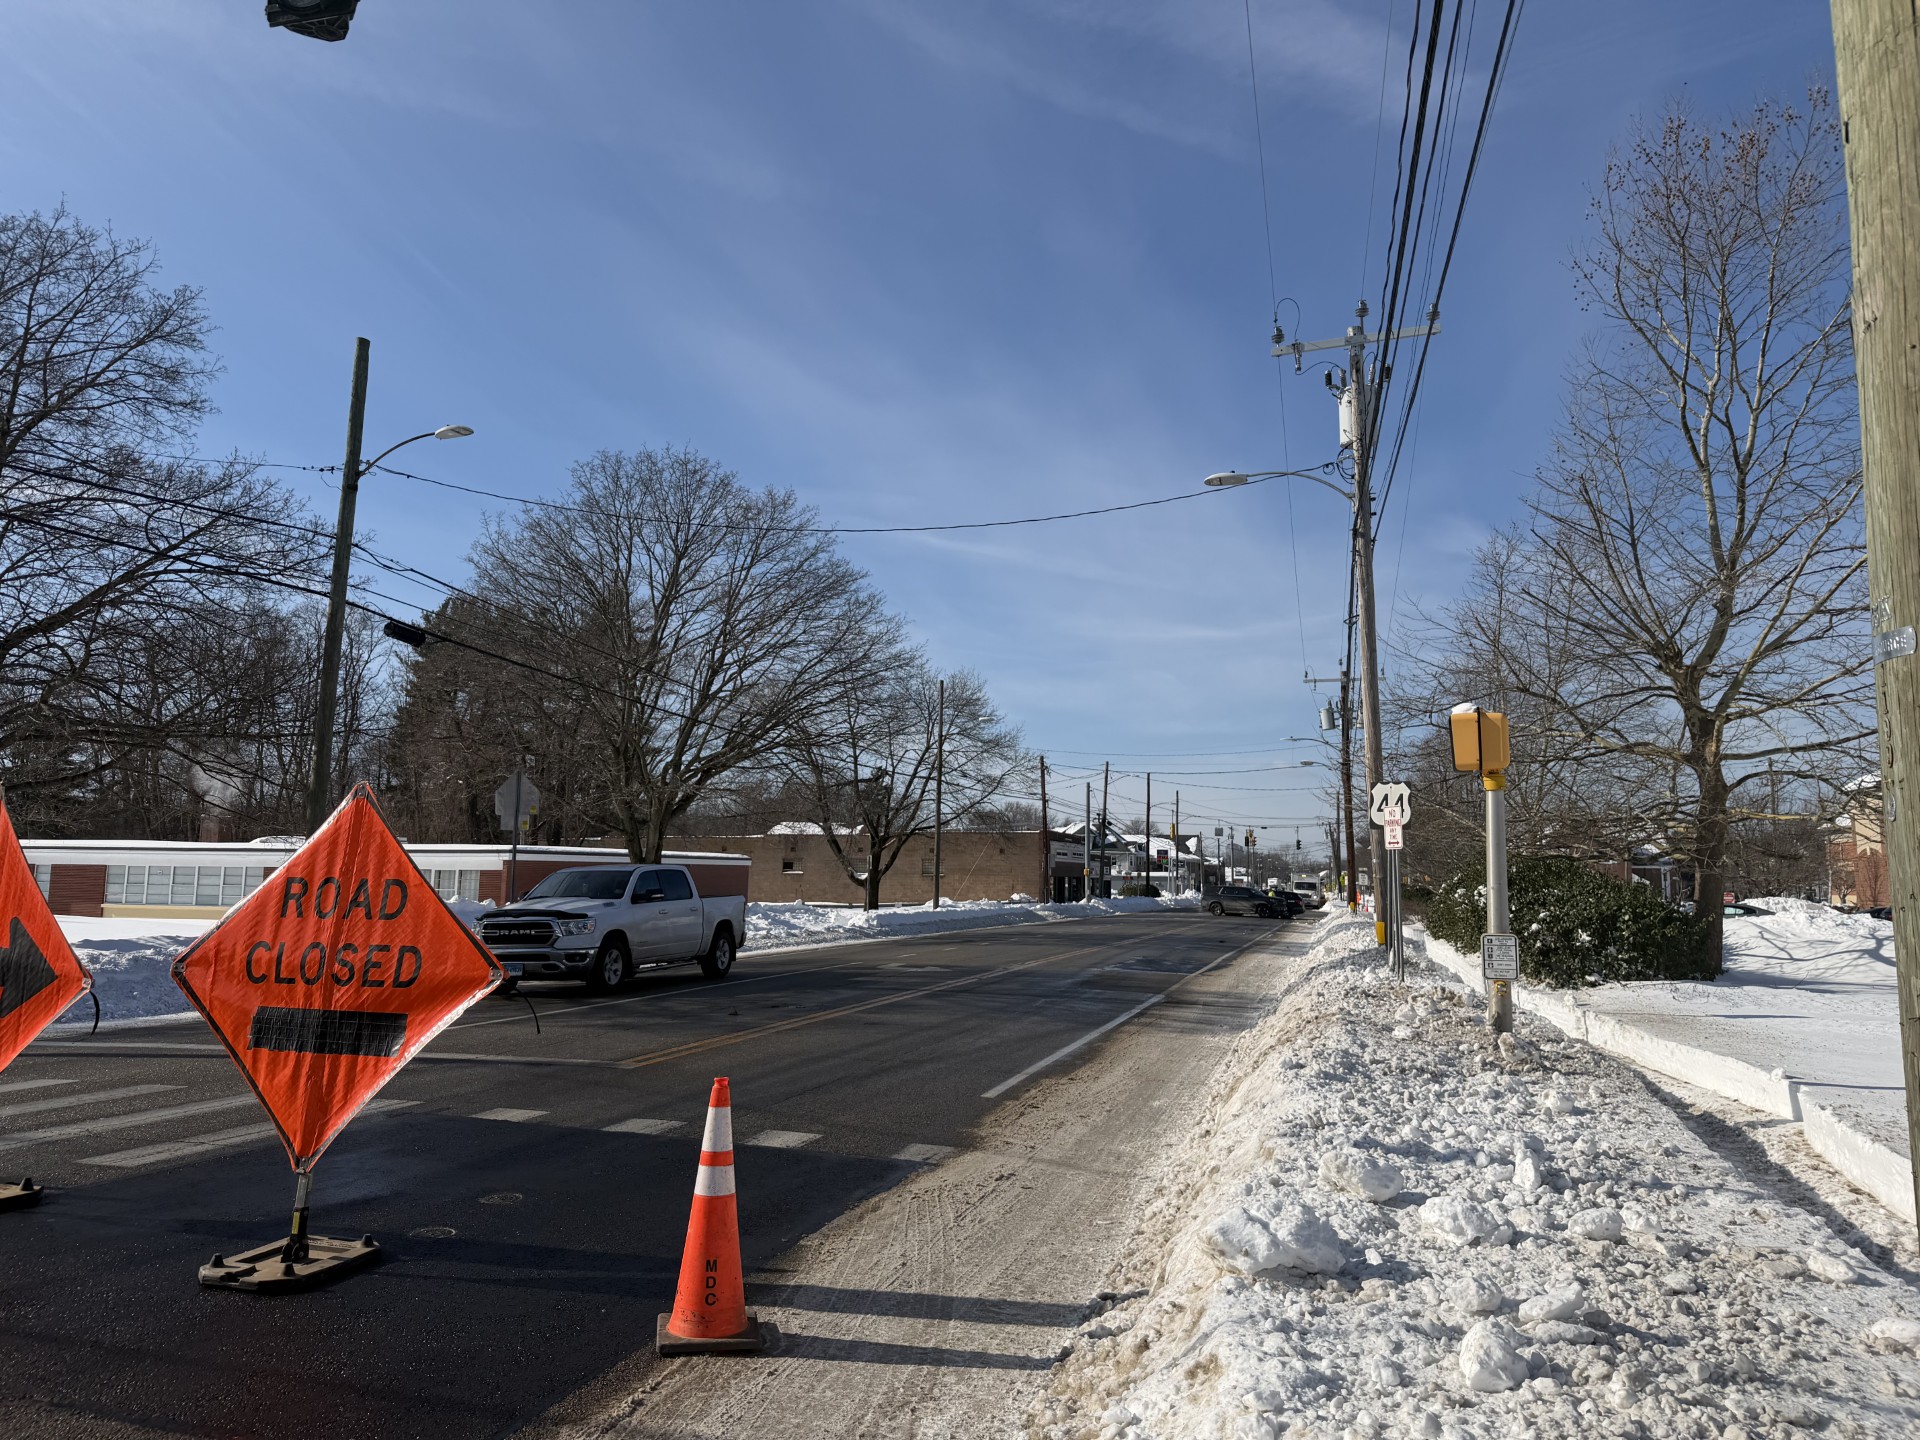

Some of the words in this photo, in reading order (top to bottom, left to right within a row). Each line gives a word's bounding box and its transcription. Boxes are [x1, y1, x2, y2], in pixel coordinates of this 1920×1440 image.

[1376, 793, 1405, 818] 44
[1384, 818, 1401, 827] PARKING
[1388, 808, 1396, 818] NO
[280, 876, 408, 920] ROAD
[246, 940, 423, 989] CLOSED
[705, 1258, 718, 1307] MDC
